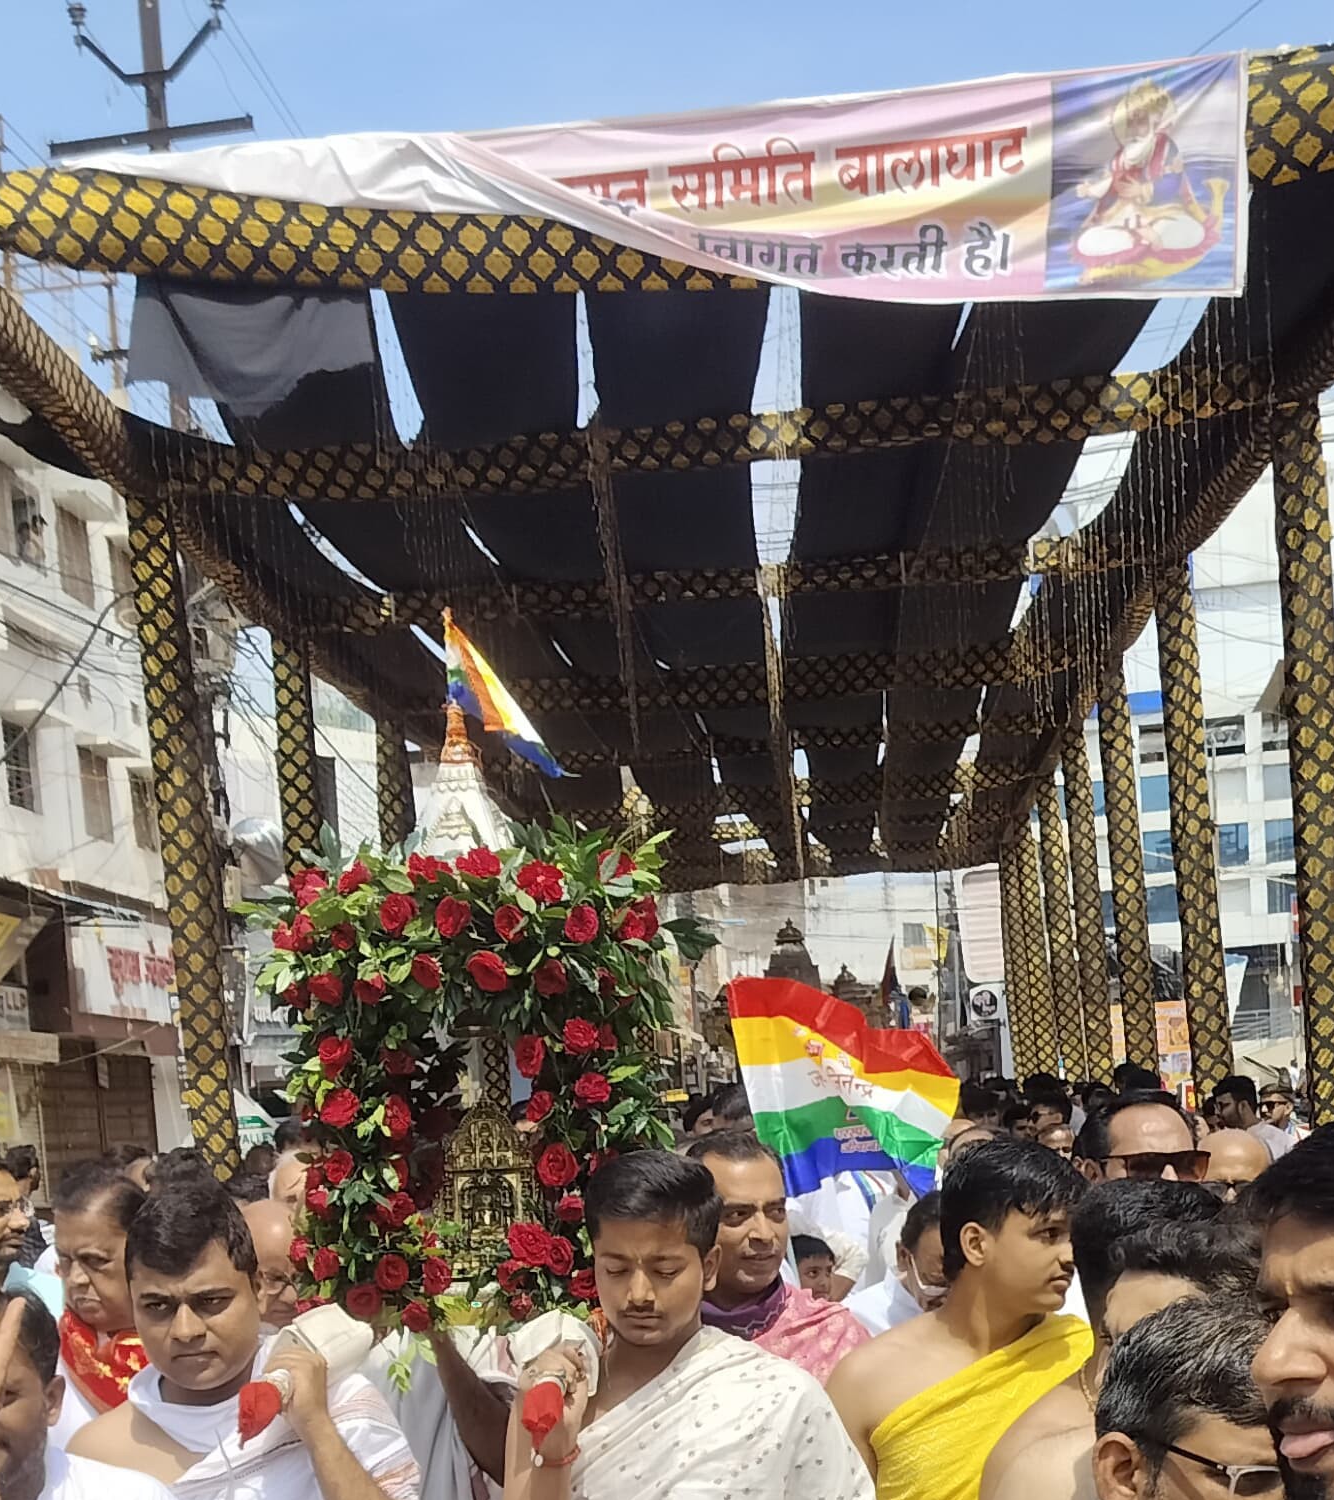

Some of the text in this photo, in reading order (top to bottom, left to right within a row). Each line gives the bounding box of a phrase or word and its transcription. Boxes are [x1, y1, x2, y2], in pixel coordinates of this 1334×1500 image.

[668, 136, 815, 213] समिति
[835, 125, 1028, 195] बालाघाट
[840, 223, 948, 276] करती
